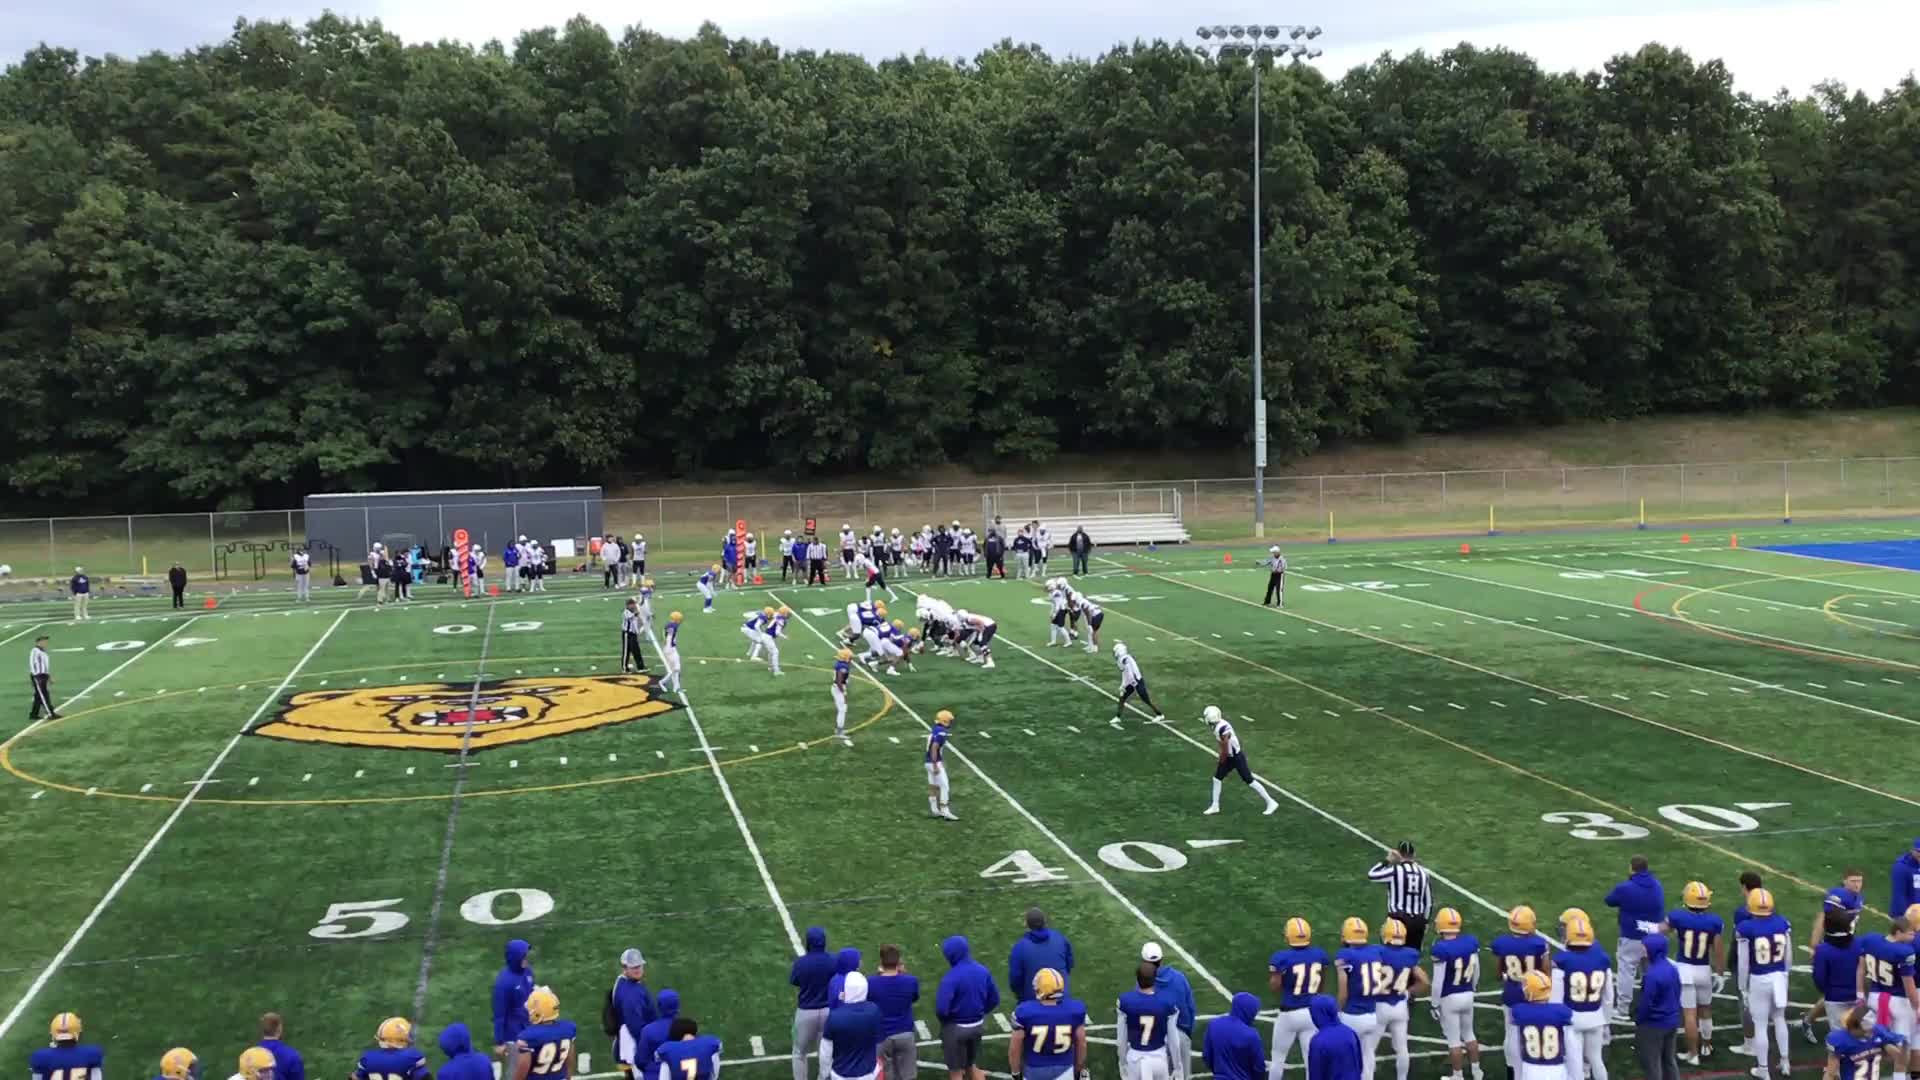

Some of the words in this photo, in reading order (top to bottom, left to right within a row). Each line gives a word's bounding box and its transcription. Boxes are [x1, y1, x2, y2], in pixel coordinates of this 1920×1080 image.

[1541, 804, 1759, 840] 30
[979, 841, 1188, 884] 40
[1407, 873, 1420, 893] H
[308, 888, 554, 938] 50
[1683, 929, 1708, 959] 11
[1754, 933, 1786, 965] 83
[1292, 962, 1322, 996] 76
[1374, 965, 1411, 996] 24
[1452, 953, 1475, 986] 14
[1505, 954, 1535, 981] 81
[1569, 970, 1606, 1002] 89
[1030, 1025, 1073, 1054] 75
[1139, 1015, 1155, 1046] 7
[1523, 1025, 1560, 1060] 88
